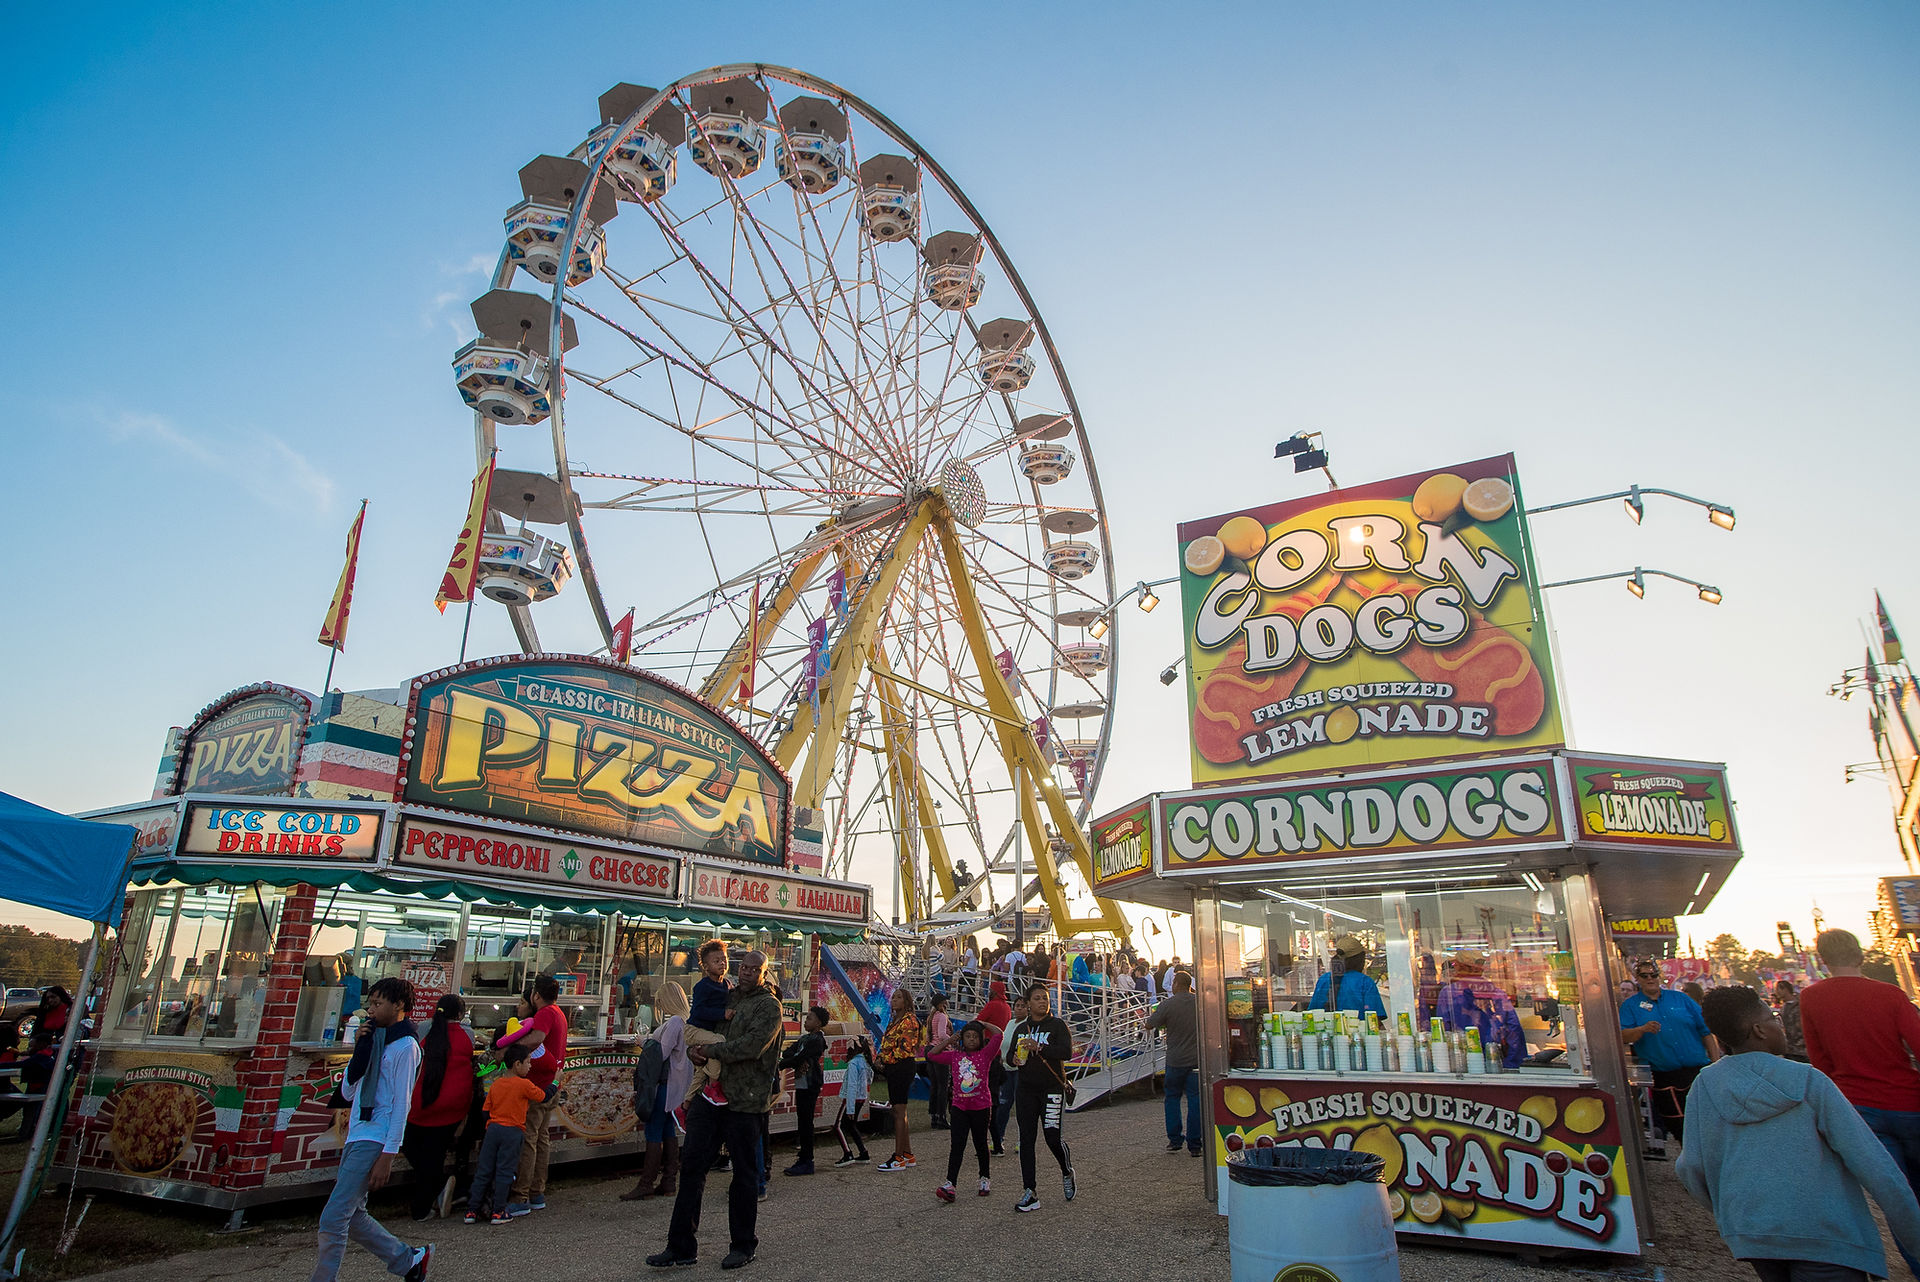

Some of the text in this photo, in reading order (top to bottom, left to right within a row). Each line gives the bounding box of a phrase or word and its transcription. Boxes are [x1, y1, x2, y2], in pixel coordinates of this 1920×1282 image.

[1195, 515, 1520, 646] CORN
[1241, 584, 1468, 672] DOGS
[214, 707, 285, 732] CLASSIC ITALIAN STYLE
[525, 681, 726, 754] CLASSIC ITALIAN STYLE
[1252, 682, 1453, 724] FRESH SQUEEZED
[1242, 704, 1490, 762] LEMONADE
[184, 722, 293, 792] PIZZA
[437, 686, 776, 849] PIZZA
[1613, 776, 1684, 791] FRESH SQUEEZED
[207, 808, 361, 835] ICE COLD
[1172, 770, 1550, 860] CORNDOGS
[1599, 793, 1710, 836] LEMONADE
[216, 831, 347, 856] DRINKS
[405, 828, 670, 889] PEPPERONI AND CHEESE
[1100, 835, 1142, 877] LEMONADE
[697, 874, 862, 915] SAUSAGE AND HAWAIIAN
[1612, 917, 1675, 932] CHOCOLATE
[404, 969, 447, 988] PIZZA
[125, 1067, 211, 1088] CLASSIC ITALIAN STYLE
[563, 1057, 590, 1069] ASSIC
[593, 1056, 628, 1065] ITALIAN
[1044, 1093, 1062, 1129] PINK
[1273, 1091, 1541, 1143] FRESH SQUEEZED
